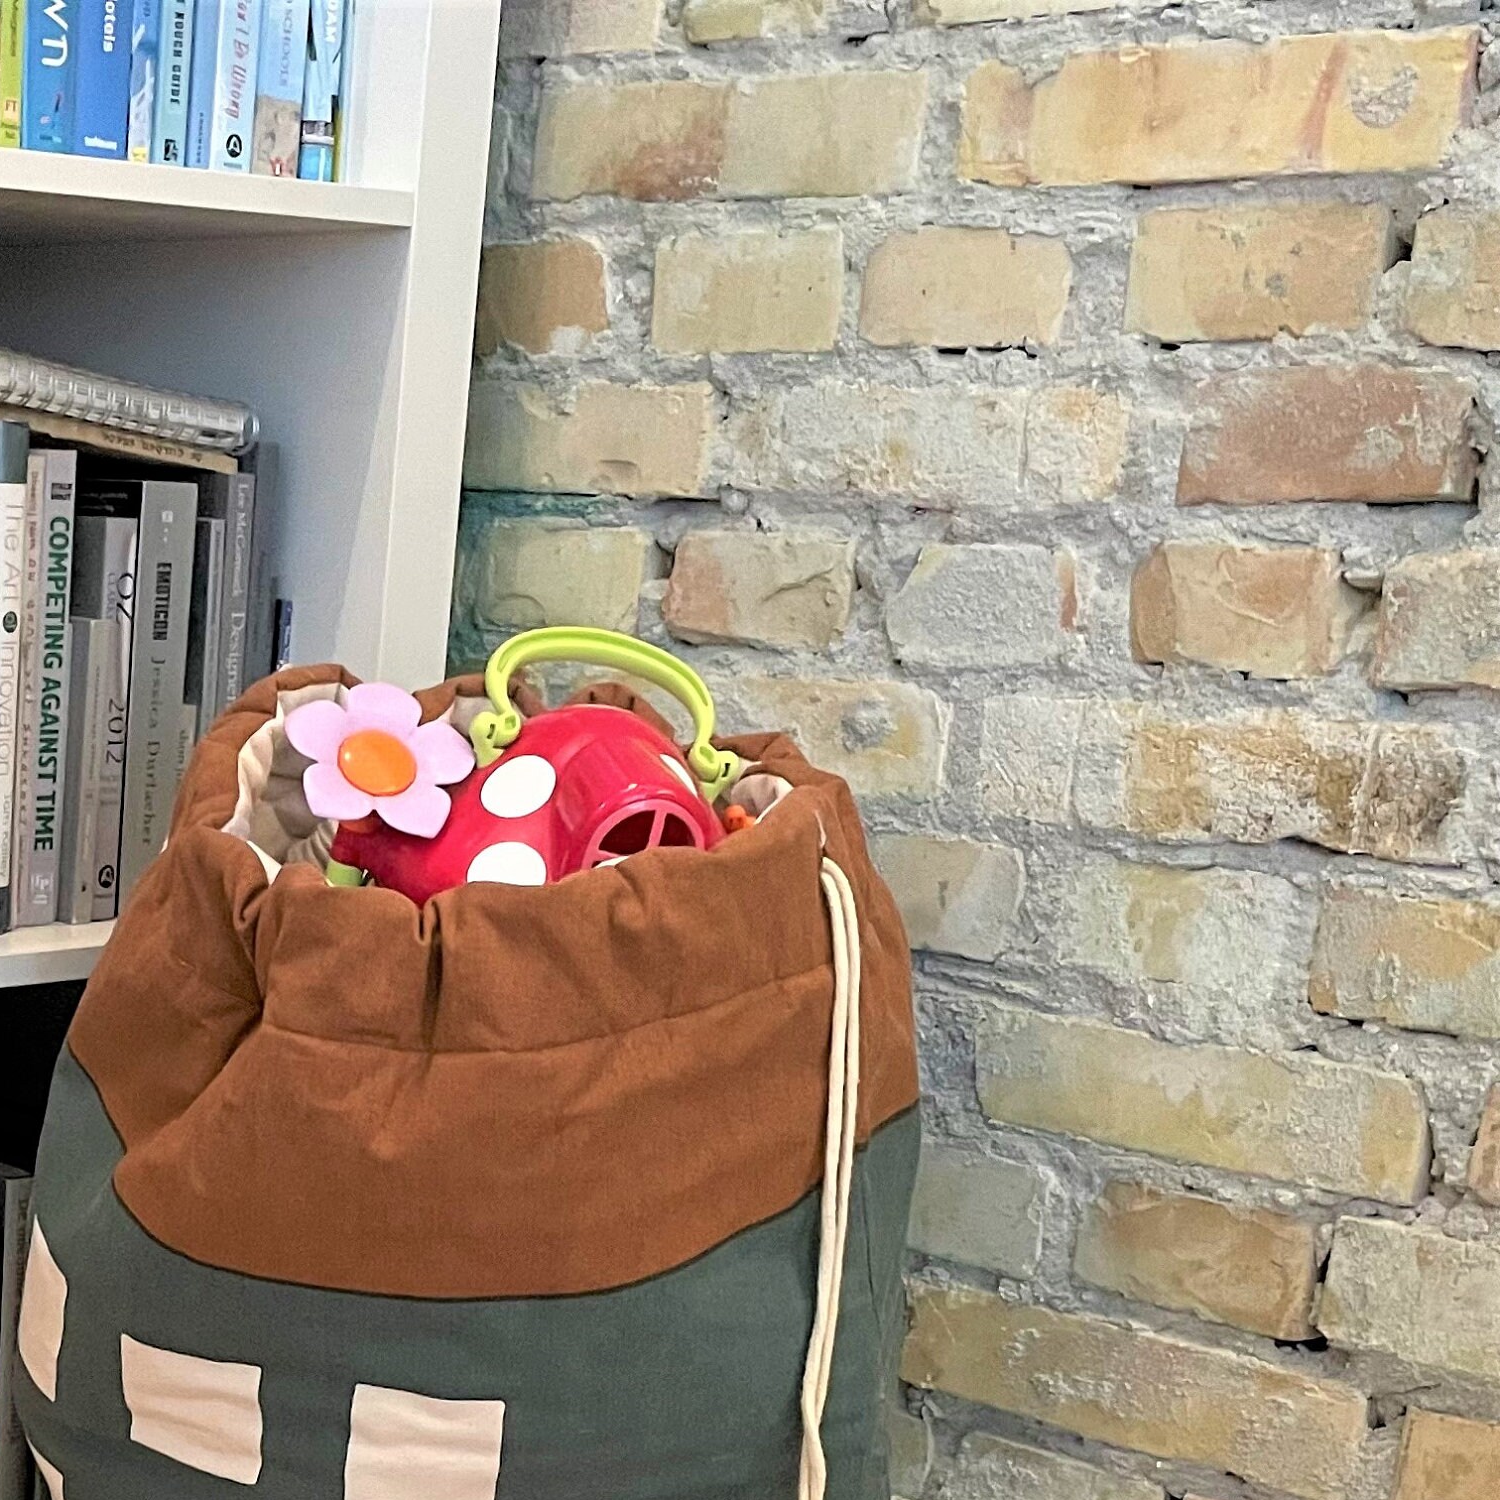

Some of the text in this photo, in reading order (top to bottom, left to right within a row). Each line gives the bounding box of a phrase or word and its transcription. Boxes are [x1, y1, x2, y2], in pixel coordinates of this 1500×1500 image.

[3, 504, 24, 600] The Art
[152, 562, 173, 642] EMOTICON
[34, 516, 70, 852] COMPETING AGAINST TIME
